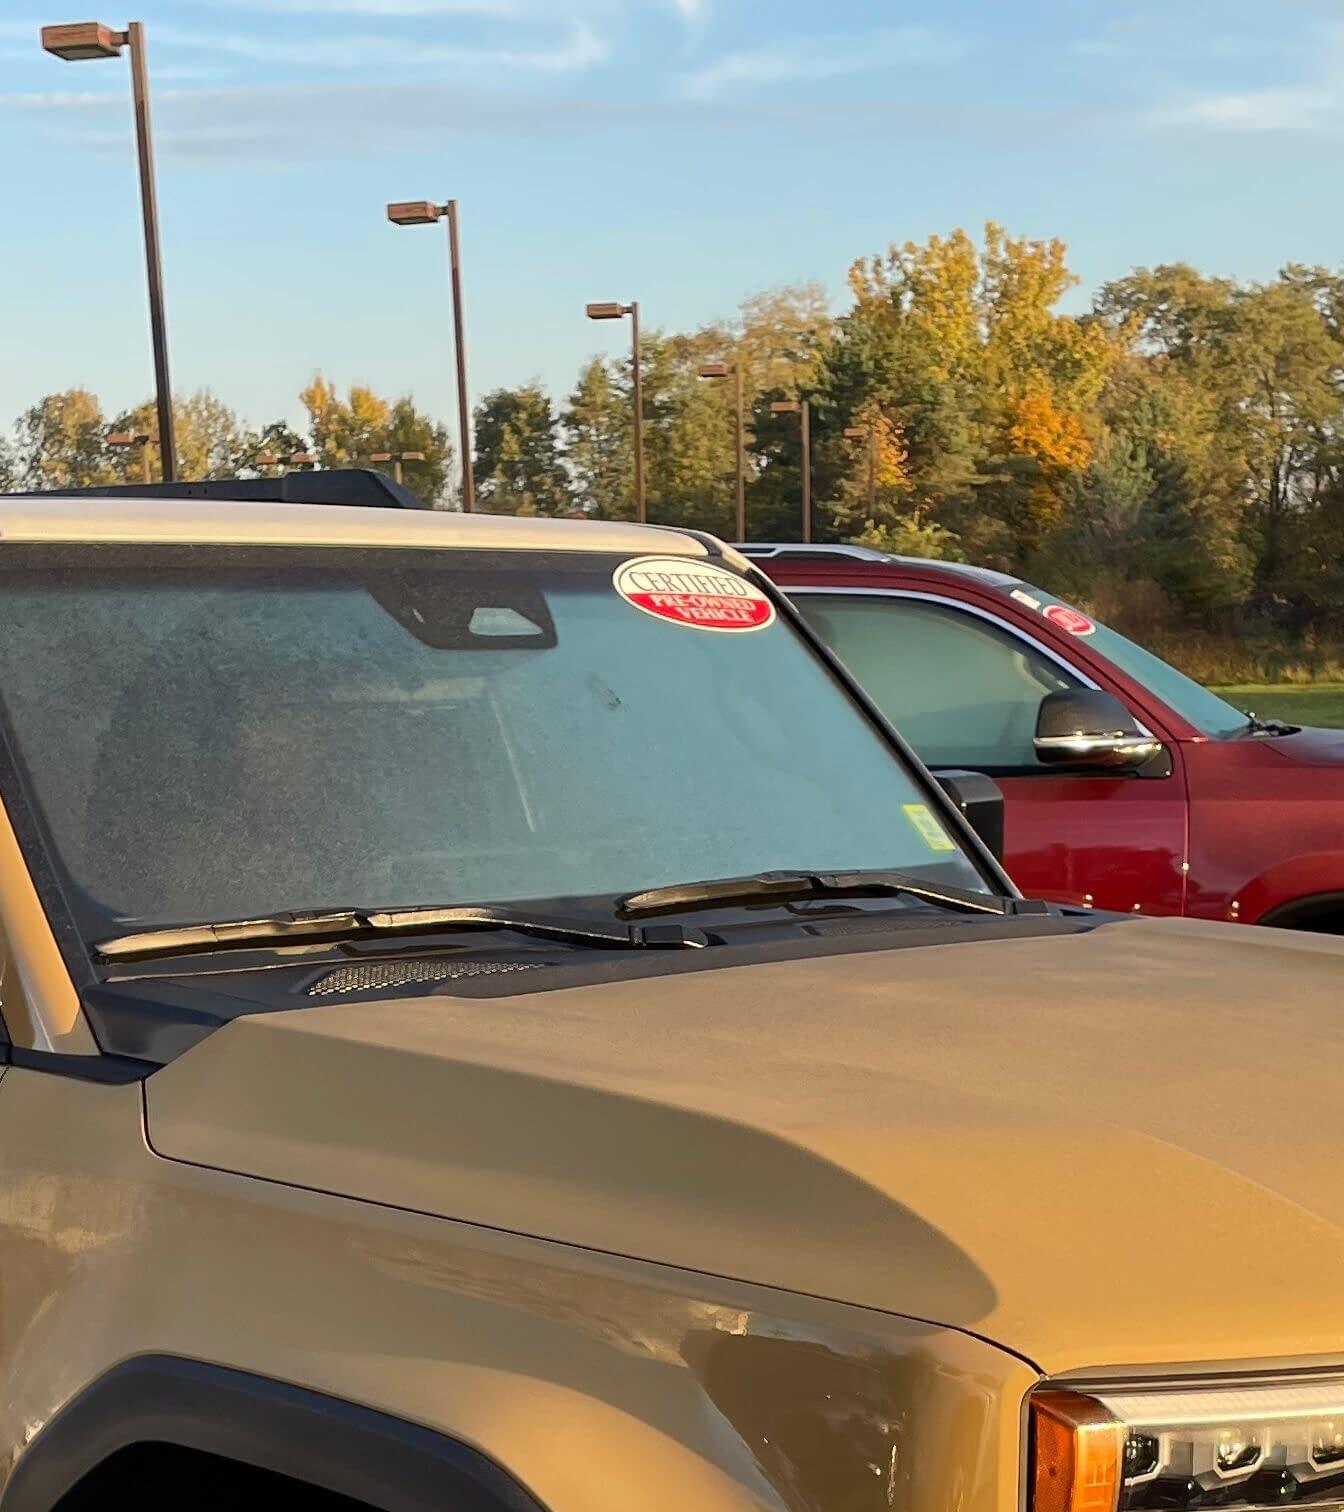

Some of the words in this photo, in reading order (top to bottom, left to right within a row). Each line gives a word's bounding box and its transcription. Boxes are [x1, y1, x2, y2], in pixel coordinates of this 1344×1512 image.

[629, 571, 747, 596] CERTIFIED
[649, 594, 757, 611] PRE-OWNED
[675, 605, 754, 622] VEHICLE
